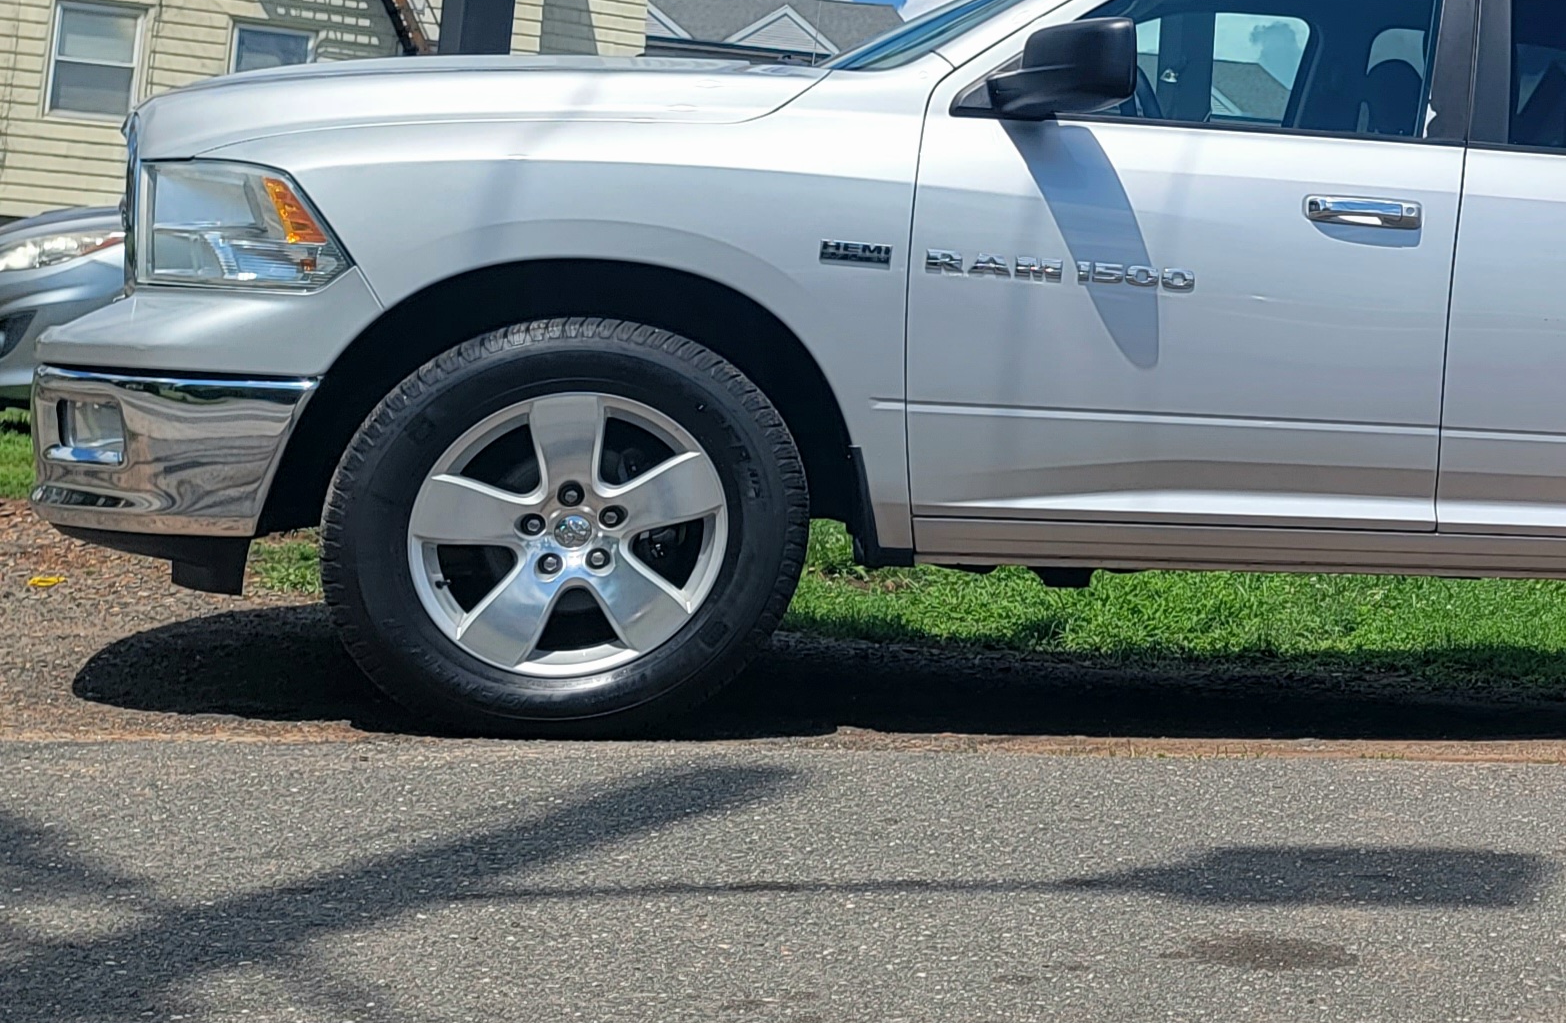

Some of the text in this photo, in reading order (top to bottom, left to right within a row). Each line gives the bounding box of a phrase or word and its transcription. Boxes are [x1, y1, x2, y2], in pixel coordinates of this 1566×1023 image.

[821, 239, 891, 257] HEMI
[924, 247, 1196, 294] RAM 1500
